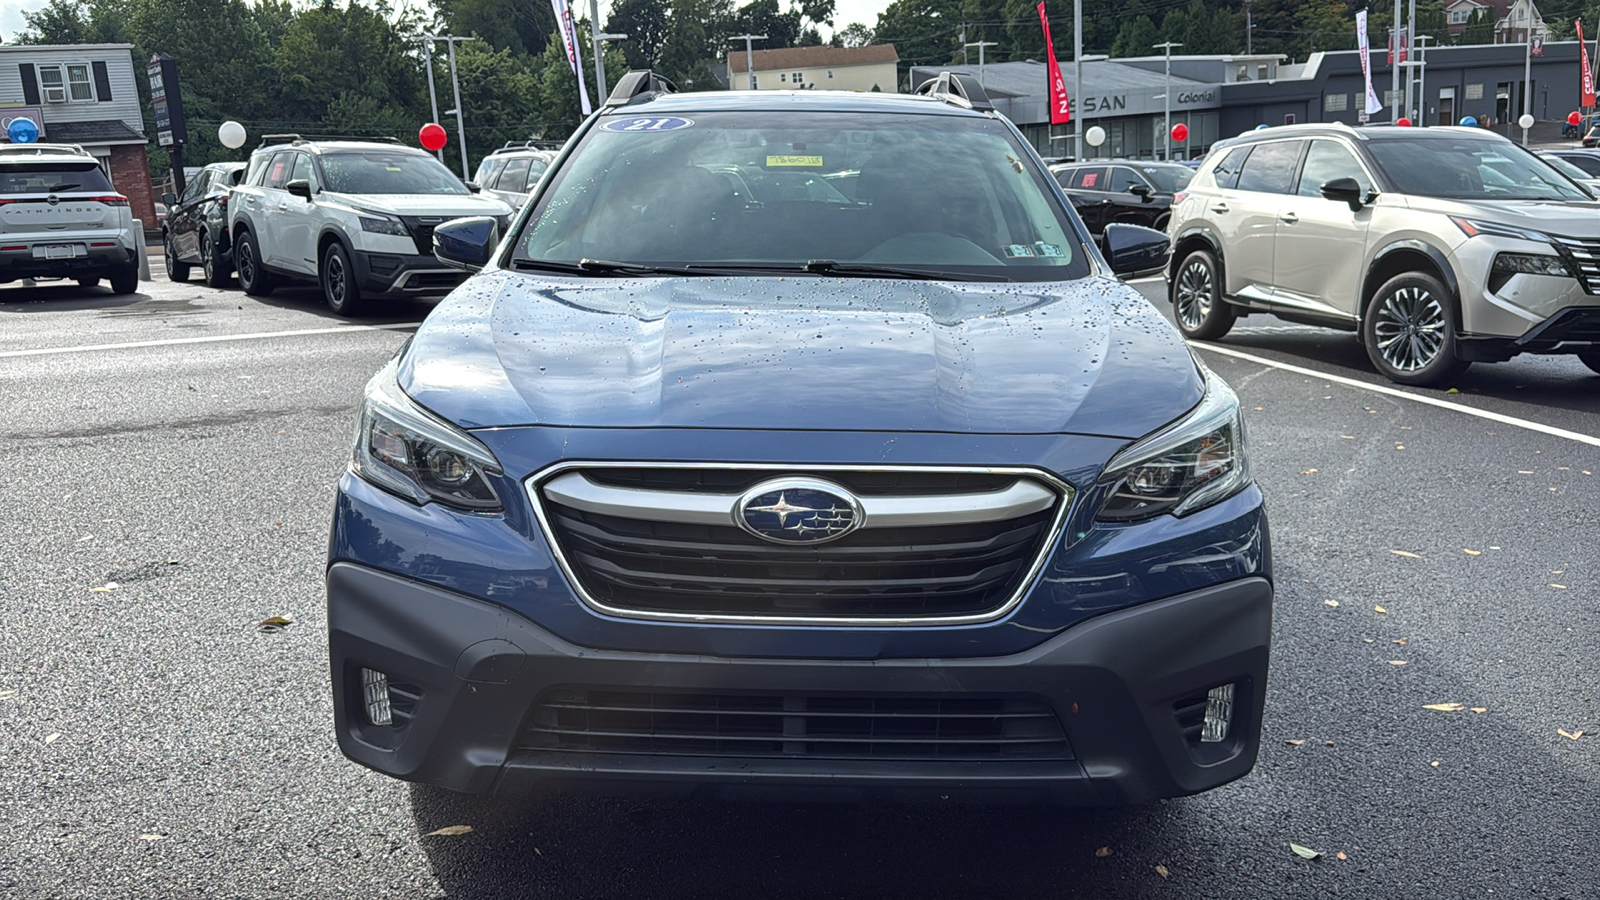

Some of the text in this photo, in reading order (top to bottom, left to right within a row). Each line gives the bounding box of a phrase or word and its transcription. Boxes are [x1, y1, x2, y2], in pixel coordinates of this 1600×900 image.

[1177, 91, 1216, 104] Colonial
[624, 119, 671, 131] 21
[5, 207, 102, 215] PATHFINDER
